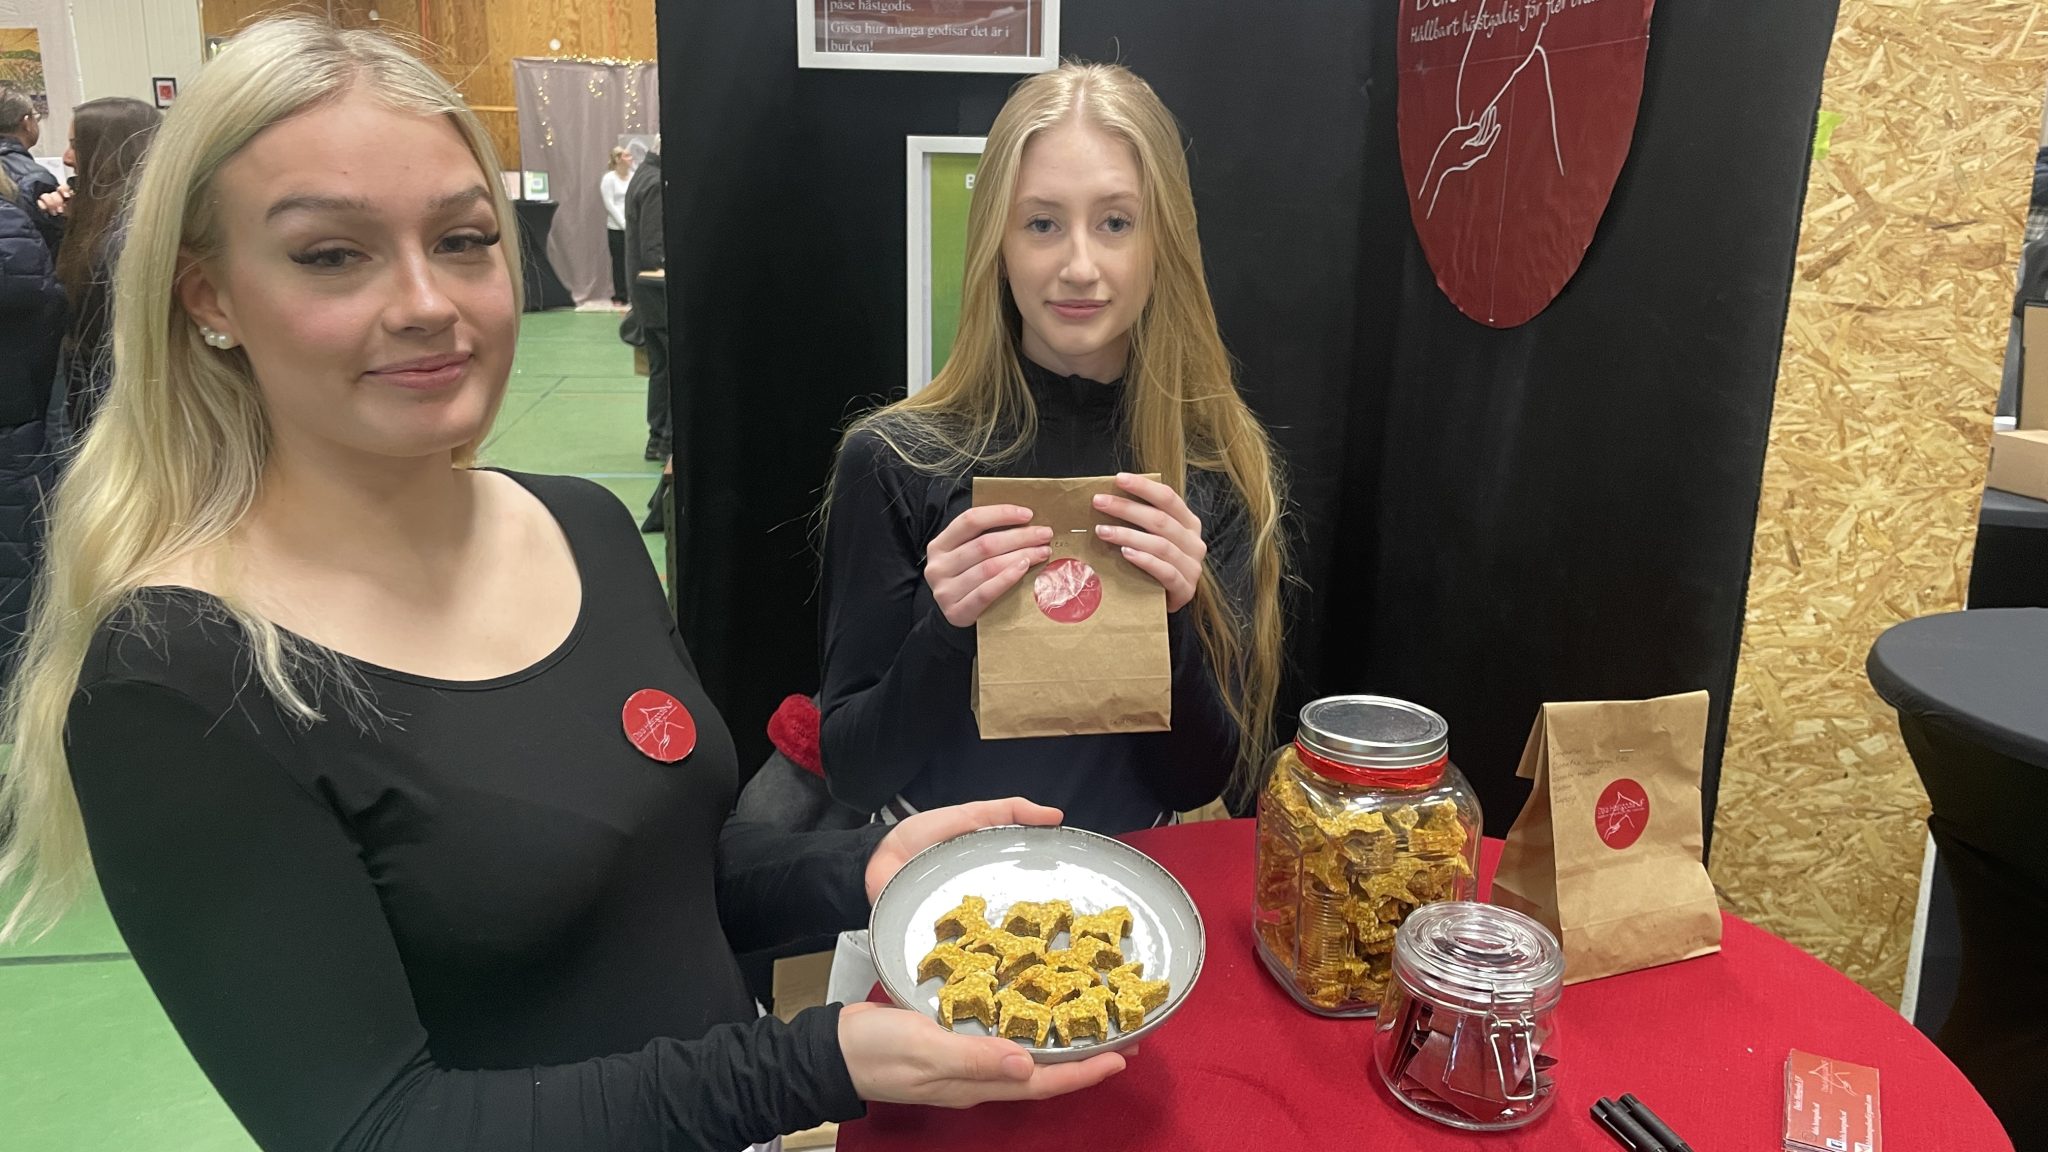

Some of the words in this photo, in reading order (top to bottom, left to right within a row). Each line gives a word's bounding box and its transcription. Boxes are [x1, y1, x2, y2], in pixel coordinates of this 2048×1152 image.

[830, 20, 862, 34] Gissa
[864, 22, 884, 35] hur
[887, 24, 924, 38] många
[927, 23, 969, 39] godisar
[970, 25, 988, 37] det
[990, 26, 1004, 37] är
[830, 40, 875, 52] burken!
